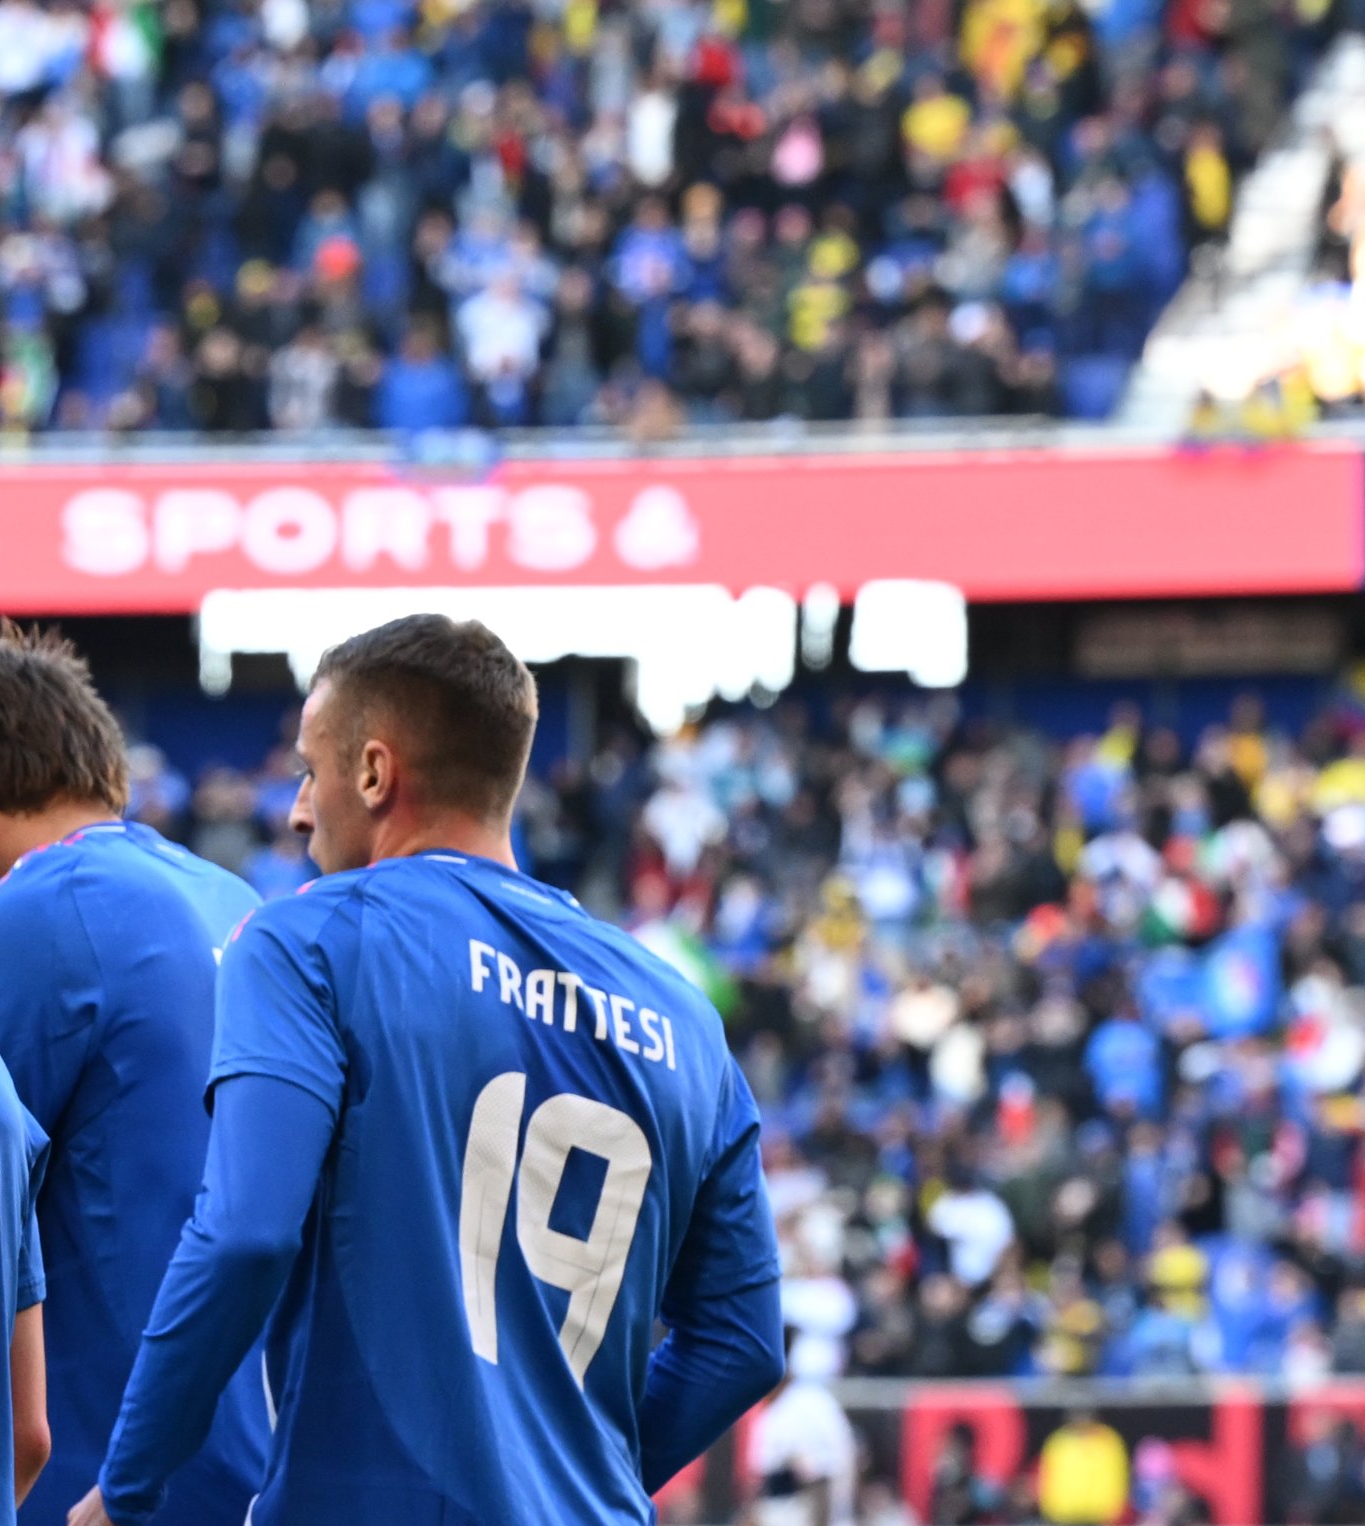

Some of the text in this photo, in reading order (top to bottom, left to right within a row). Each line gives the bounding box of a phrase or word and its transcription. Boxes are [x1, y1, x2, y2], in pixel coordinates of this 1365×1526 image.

[61, 484, 597, 576] SPORTS
[469, 938, 677, 1071] FRATTESI
[459, 1071, 653, 1392] 19
